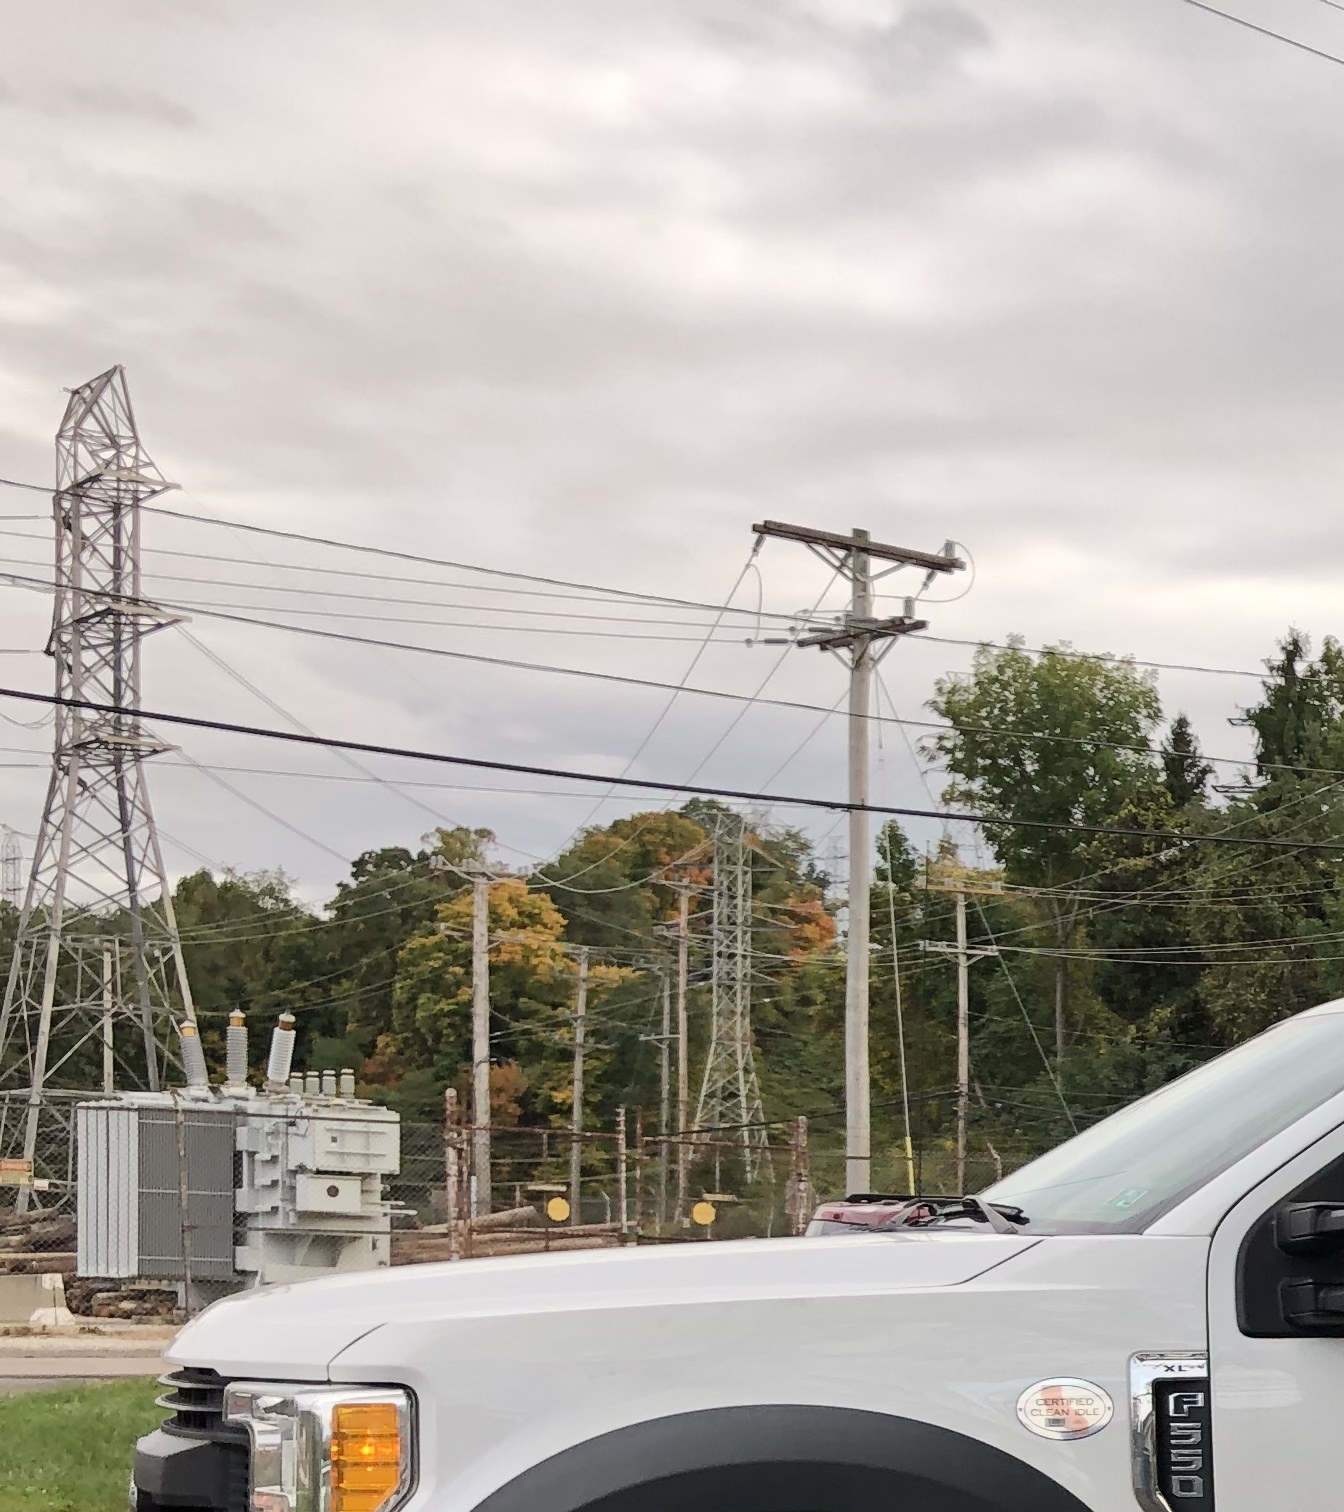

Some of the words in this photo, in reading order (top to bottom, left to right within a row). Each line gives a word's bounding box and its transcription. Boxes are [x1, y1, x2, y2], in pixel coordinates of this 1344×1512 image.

[1163, 1364, 1188, 1373] XL
[1035, 1397, 1095, 1406] CERTIFIED
[1030, 1408, 1070, 1417] CLEAN
[1074, 1408, 1100, 1416] IDLE
[1167, 1392, 1205, 1498] F550
